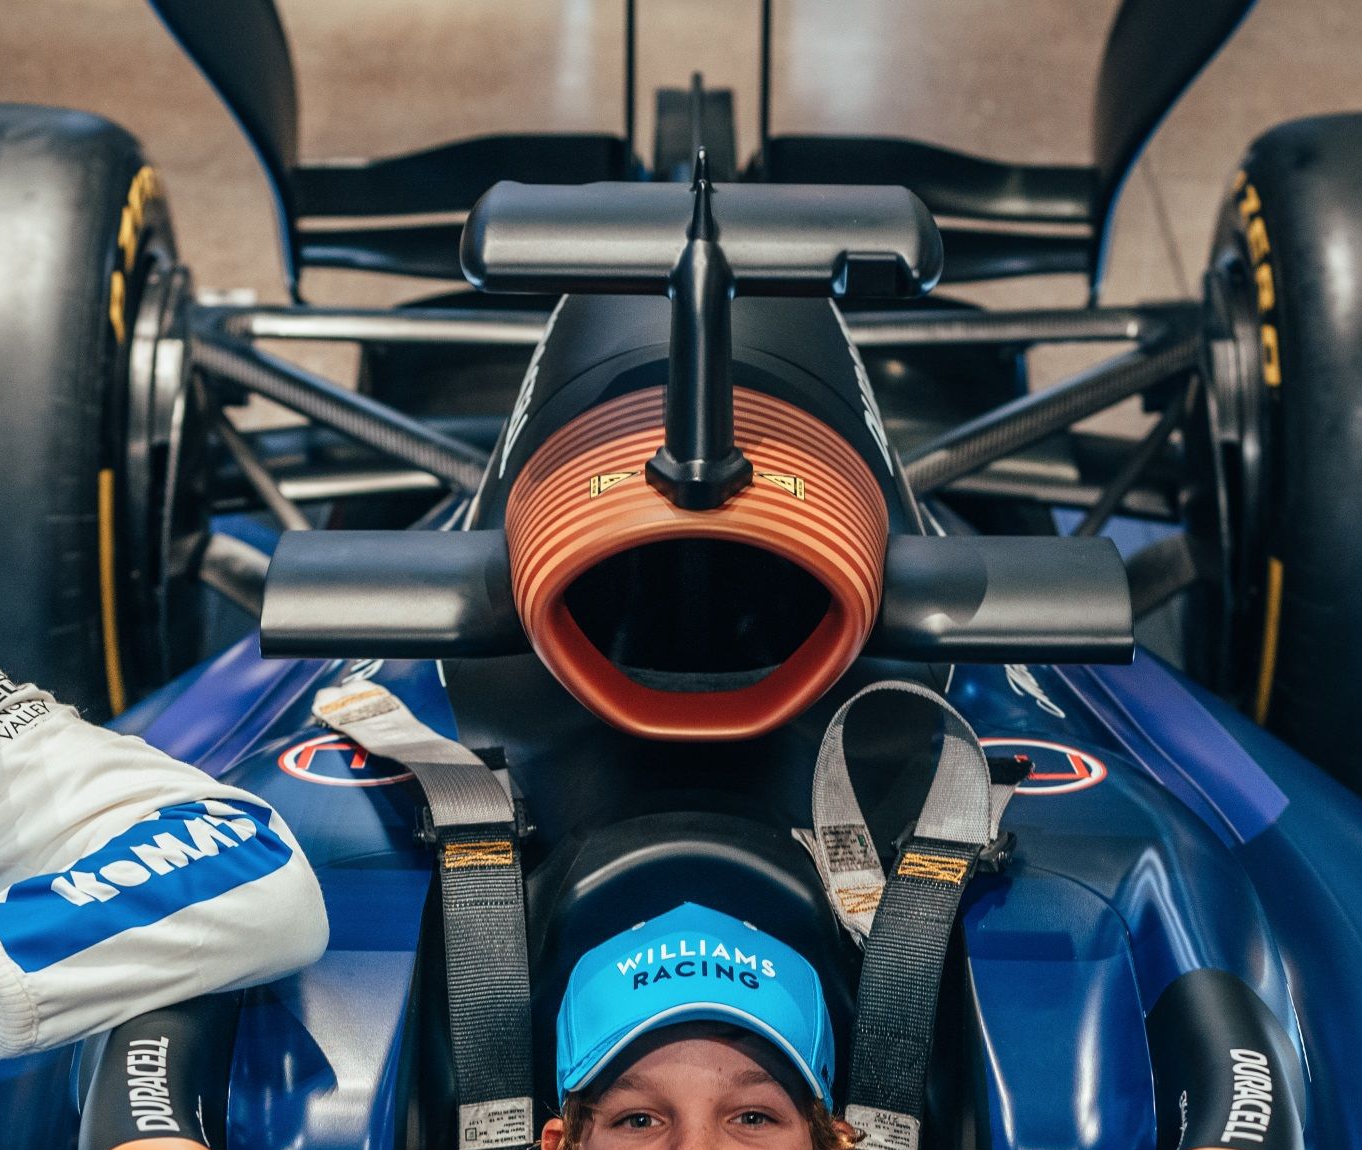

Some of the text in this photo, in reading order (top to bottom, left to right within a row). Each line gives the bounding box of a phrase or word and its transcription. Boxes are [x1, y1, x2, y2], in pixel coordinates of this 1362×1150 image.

[616, 939, 776, 979] WILLIAMS
[632, 960, 760, 990] RACING
[127, 1035, 181, 1133] DURACELL
[1220, 1048, 1273, 1144] DURACELL
